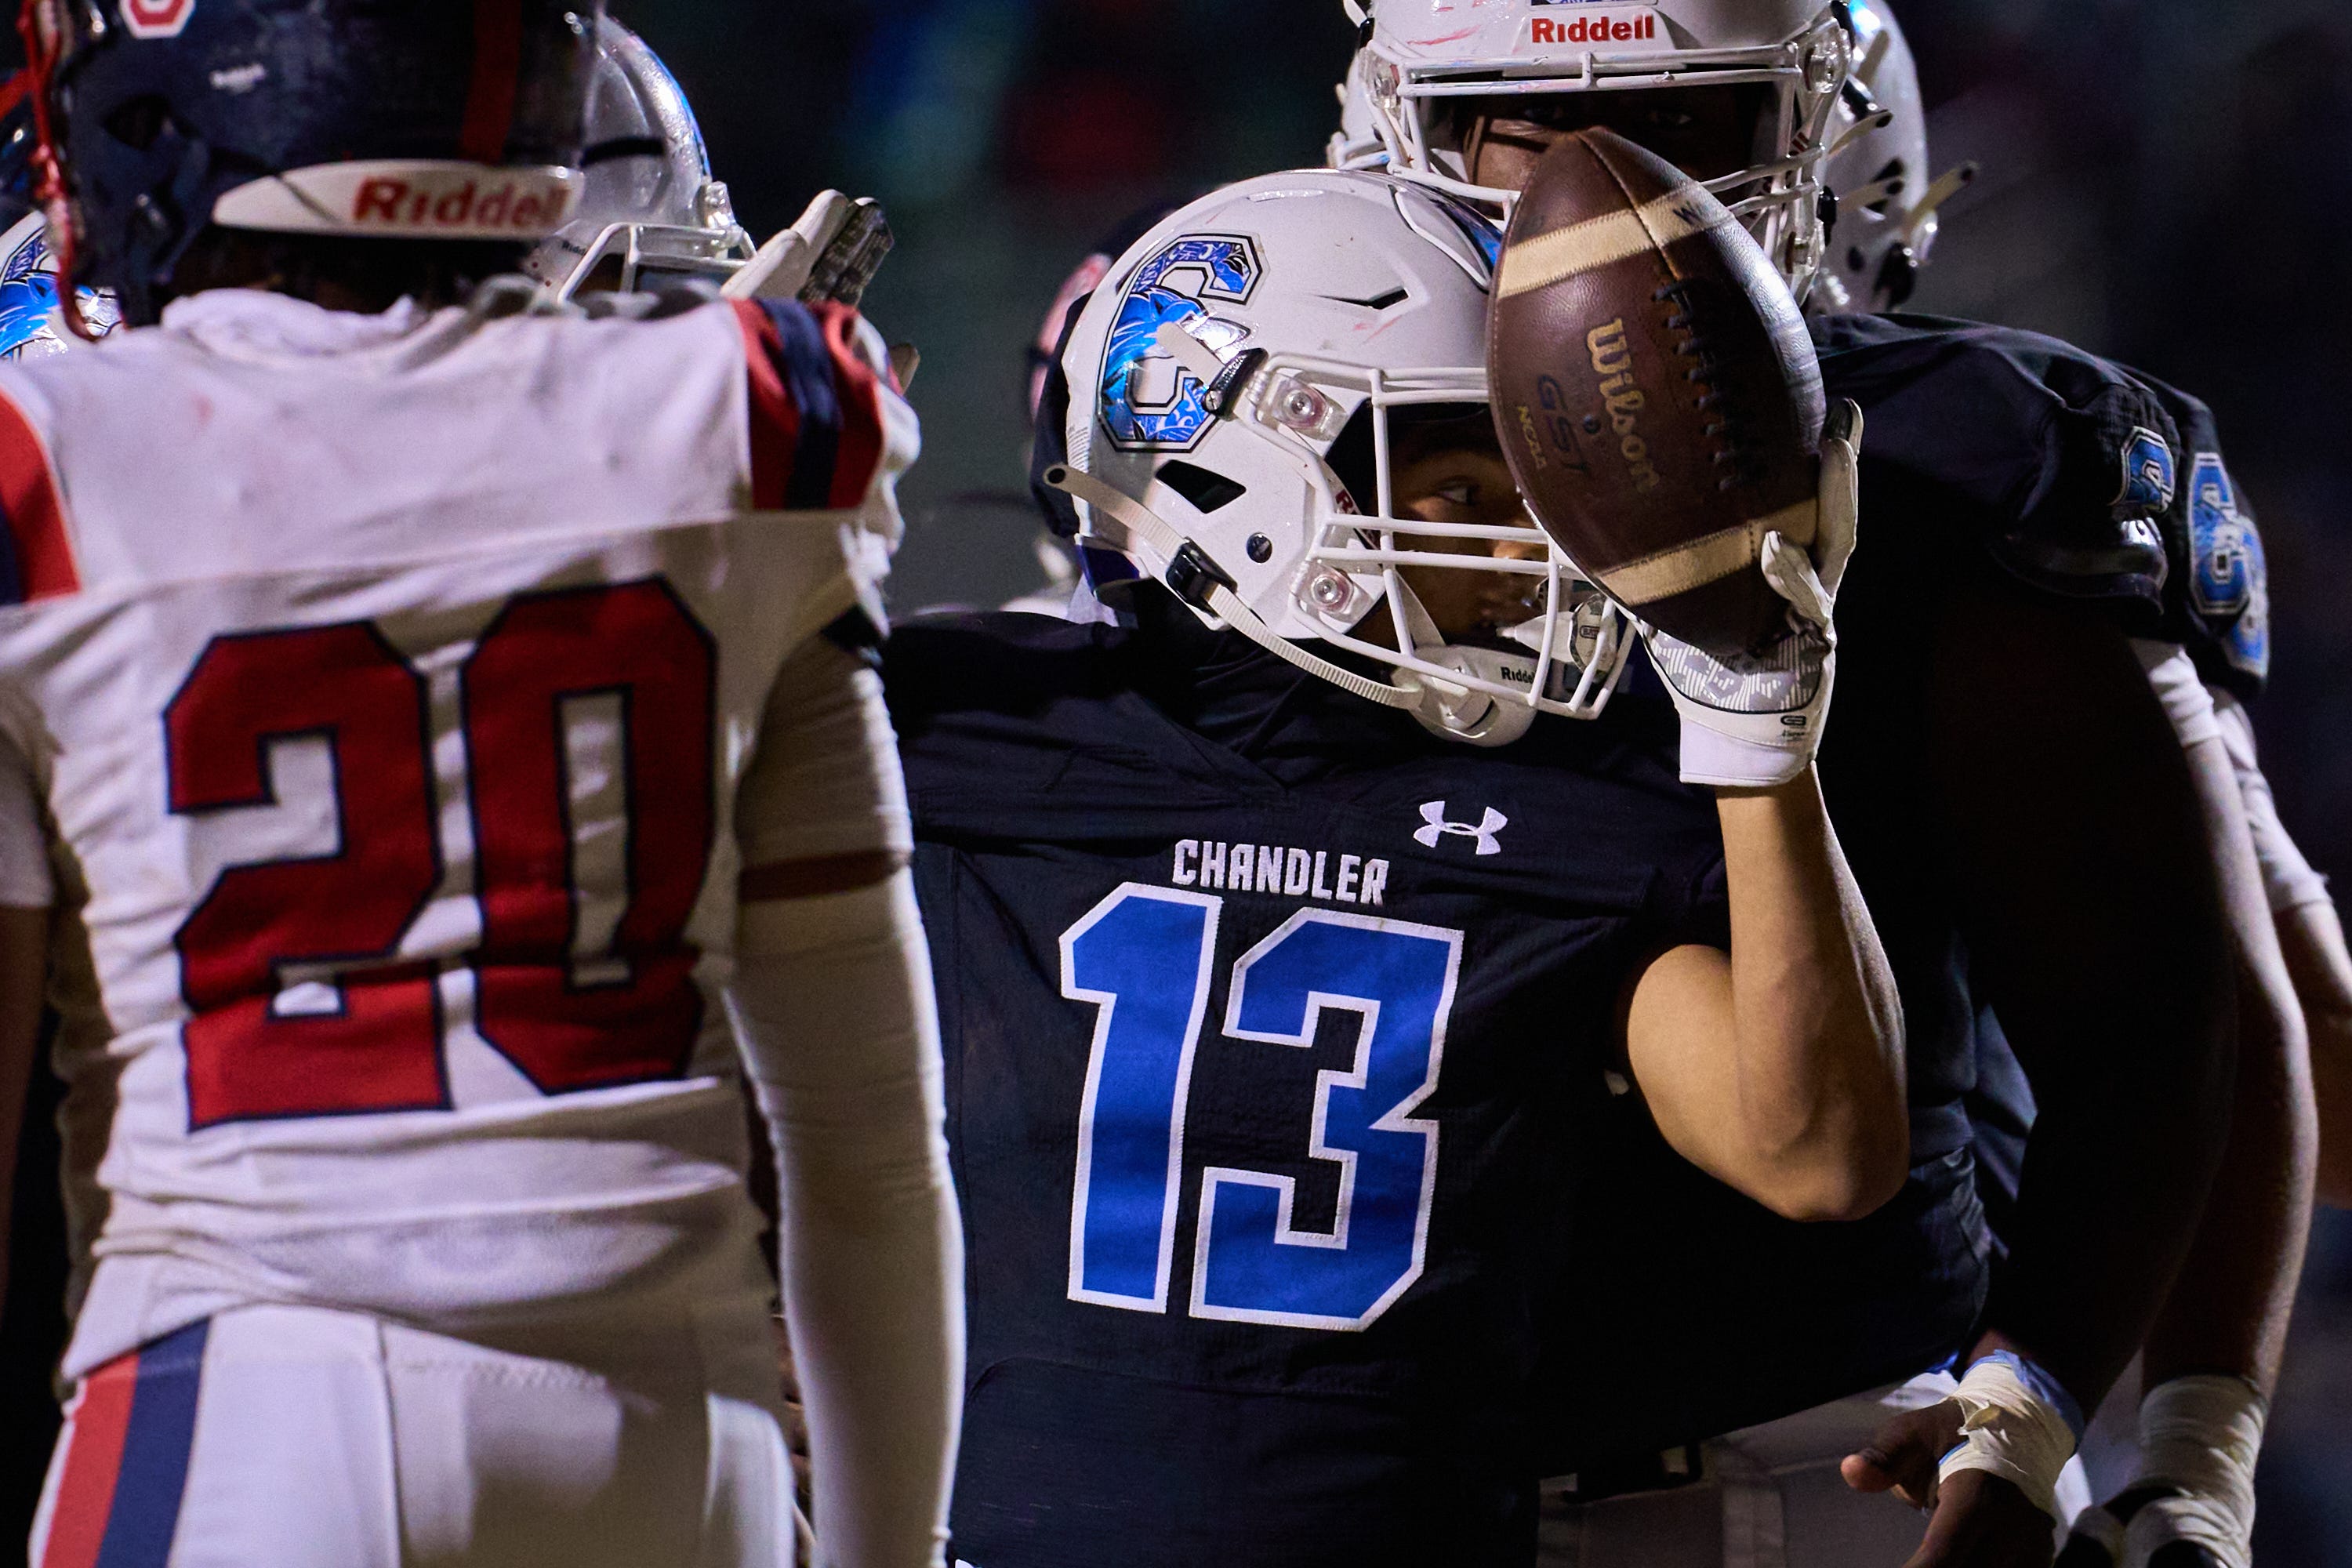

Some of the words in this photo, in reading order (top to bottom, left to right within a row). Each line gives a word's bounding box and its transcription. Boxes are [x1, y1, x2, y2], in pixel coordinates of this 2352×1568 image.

[1532, 14, 1654, 43] Riddell
[353, 177, 571, 227] Riddell
[561, 240, 586, 256] Ridd
[1518, 405, 1548, 470] NCAA
[1537, 375, 1589, 477] GST
[1587, 318, 1661, 494] Wilson
[162, 572, 719, 1134] 20
[1172, 838, 1389, 906] CHANDLER
[1058, 880, 1465, 1333] 13
